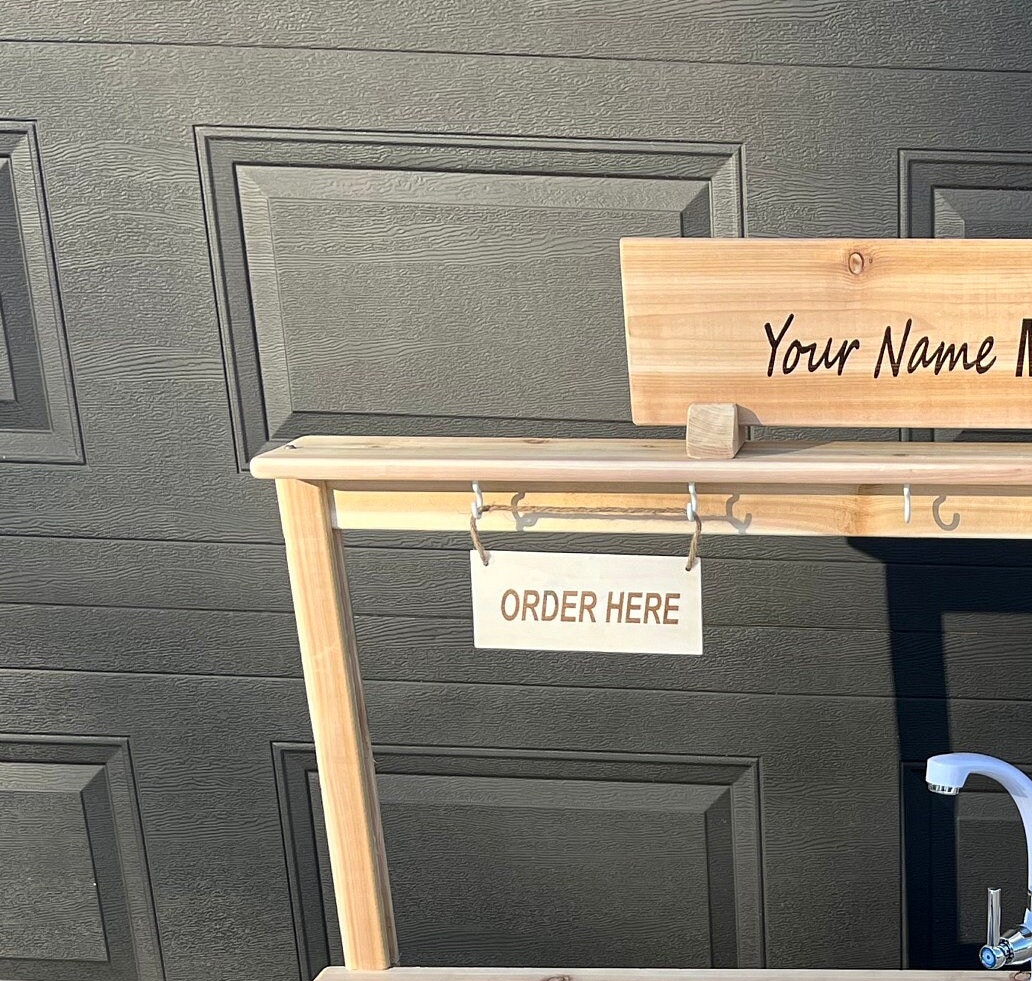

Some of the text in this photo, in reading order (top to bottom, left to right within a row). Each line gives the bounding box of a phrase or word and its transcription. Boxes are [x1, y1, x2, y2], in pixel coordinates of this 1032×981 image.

[763, 313, 861, 379] Your
[872, 318, 998, 380] Name
[500, 589, 682, 626] ORDER HERE
